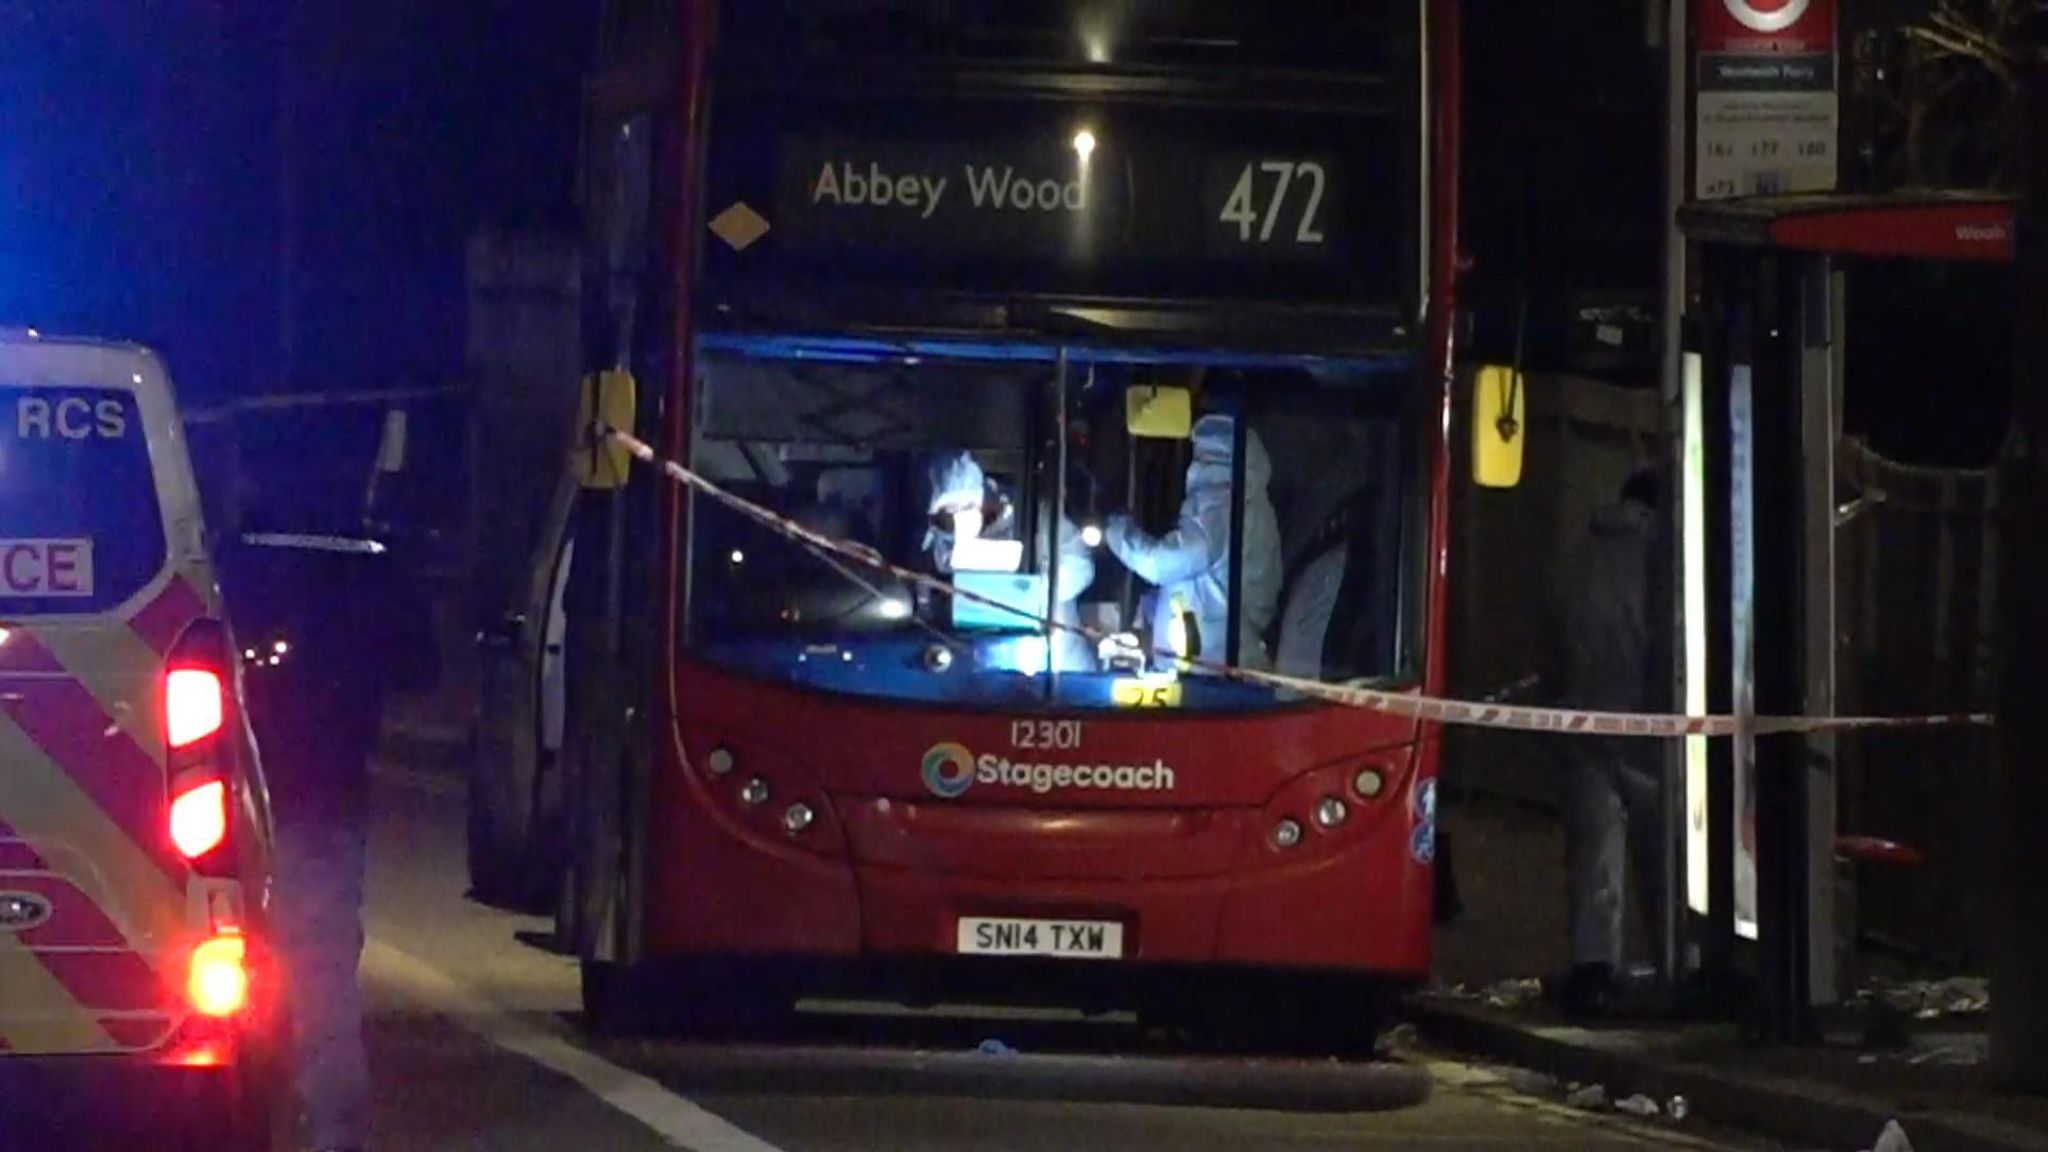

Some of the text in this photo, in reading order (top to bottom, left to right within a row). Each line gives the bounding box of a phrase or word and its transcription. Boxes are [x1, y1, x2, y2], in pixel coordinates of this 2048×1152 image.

[813, 161, 1087, 218] Abbey Wood
[1219, 161, 1326, 242] 472
[17, 397, 126, 439] RCS
[1011, 719, 1082, 748] 12301
[976, 753, 1175, 793] Stagecoach
[976, 922, 1104, 951] SN14 TXW
